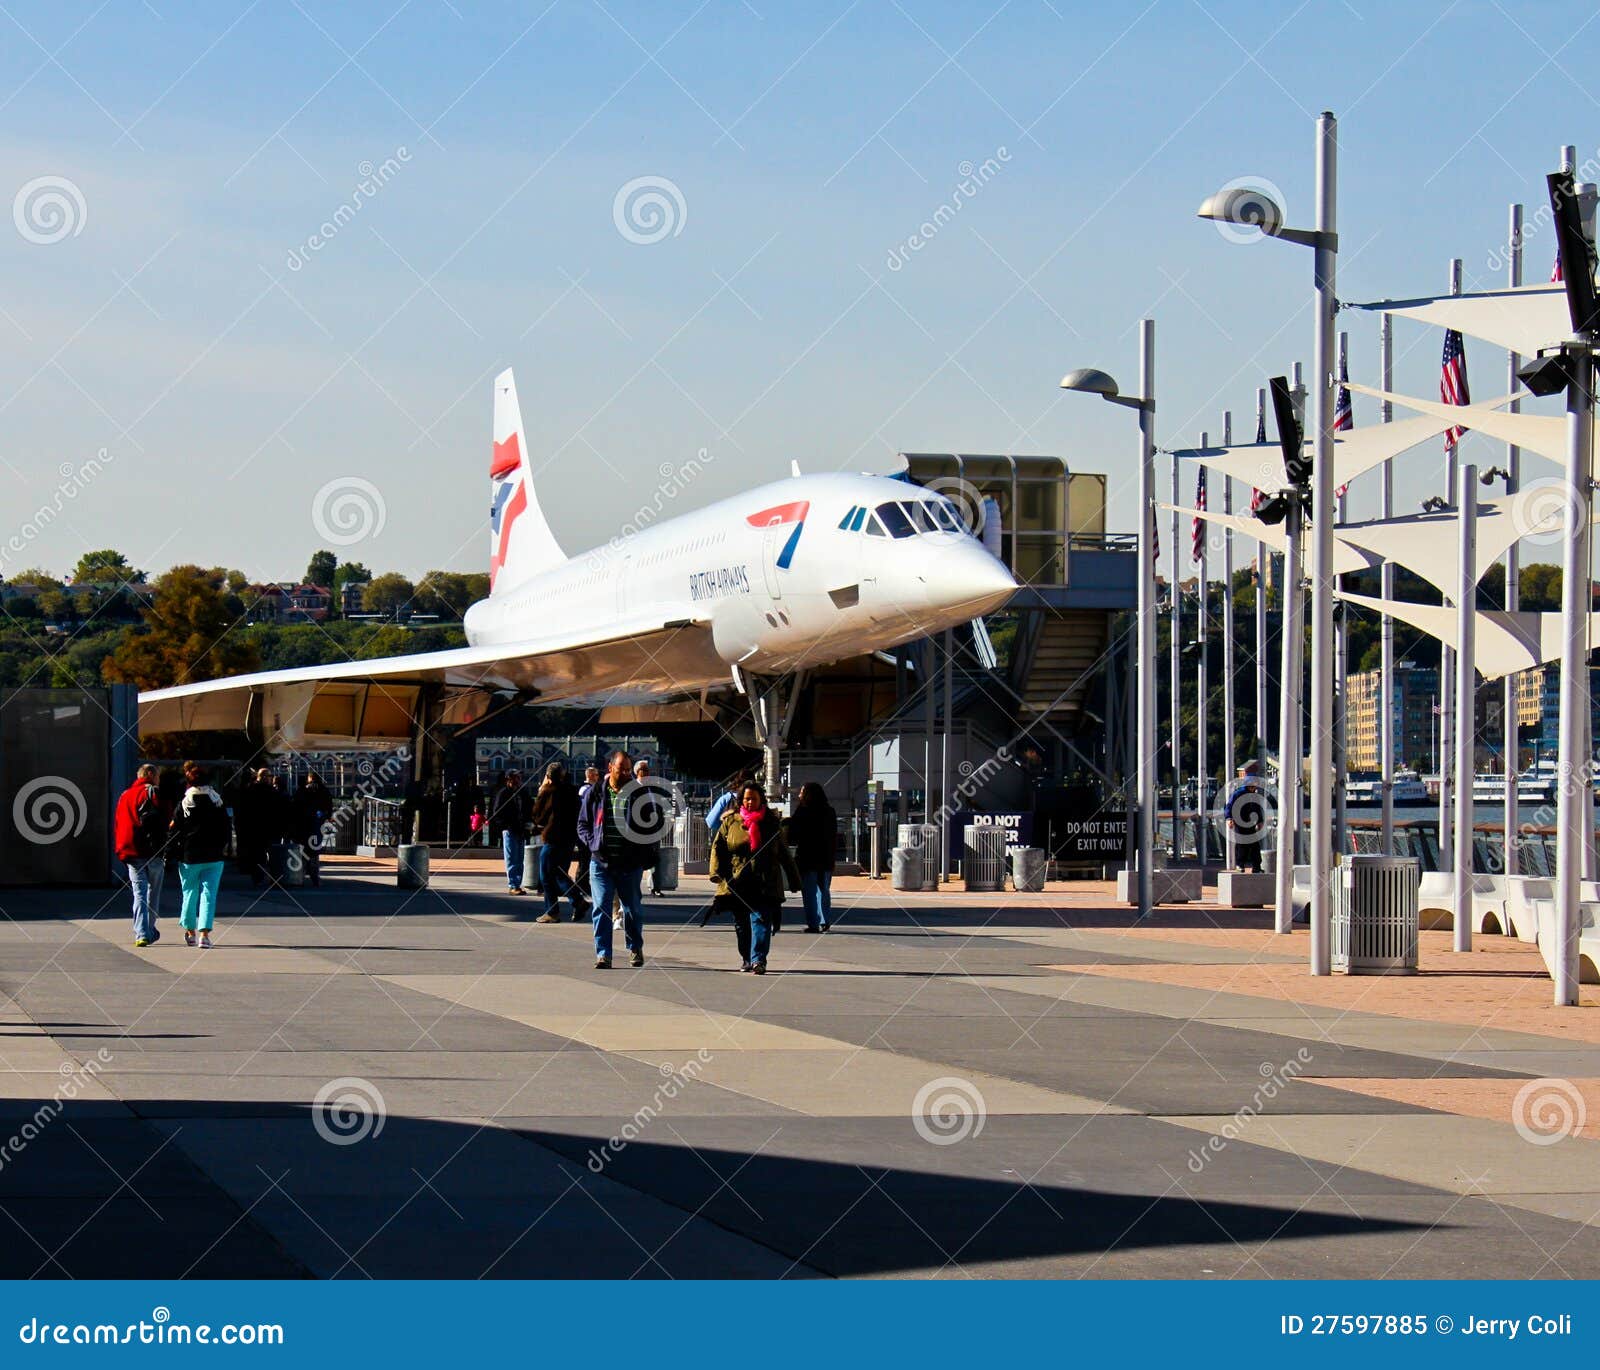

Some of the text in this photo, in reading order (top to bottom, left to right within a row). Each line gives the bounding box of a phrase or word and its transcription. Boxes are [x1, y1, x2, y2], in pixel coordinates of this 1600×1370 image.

[689, 565, 749, 600] BRITISH AIRWAYS
[973, 815, 1022, 827] DO NOT
[1067, 821, 1127, 834] DO NOT ENTE
[1077, 838, 1123, 850] EXIT ONLY
